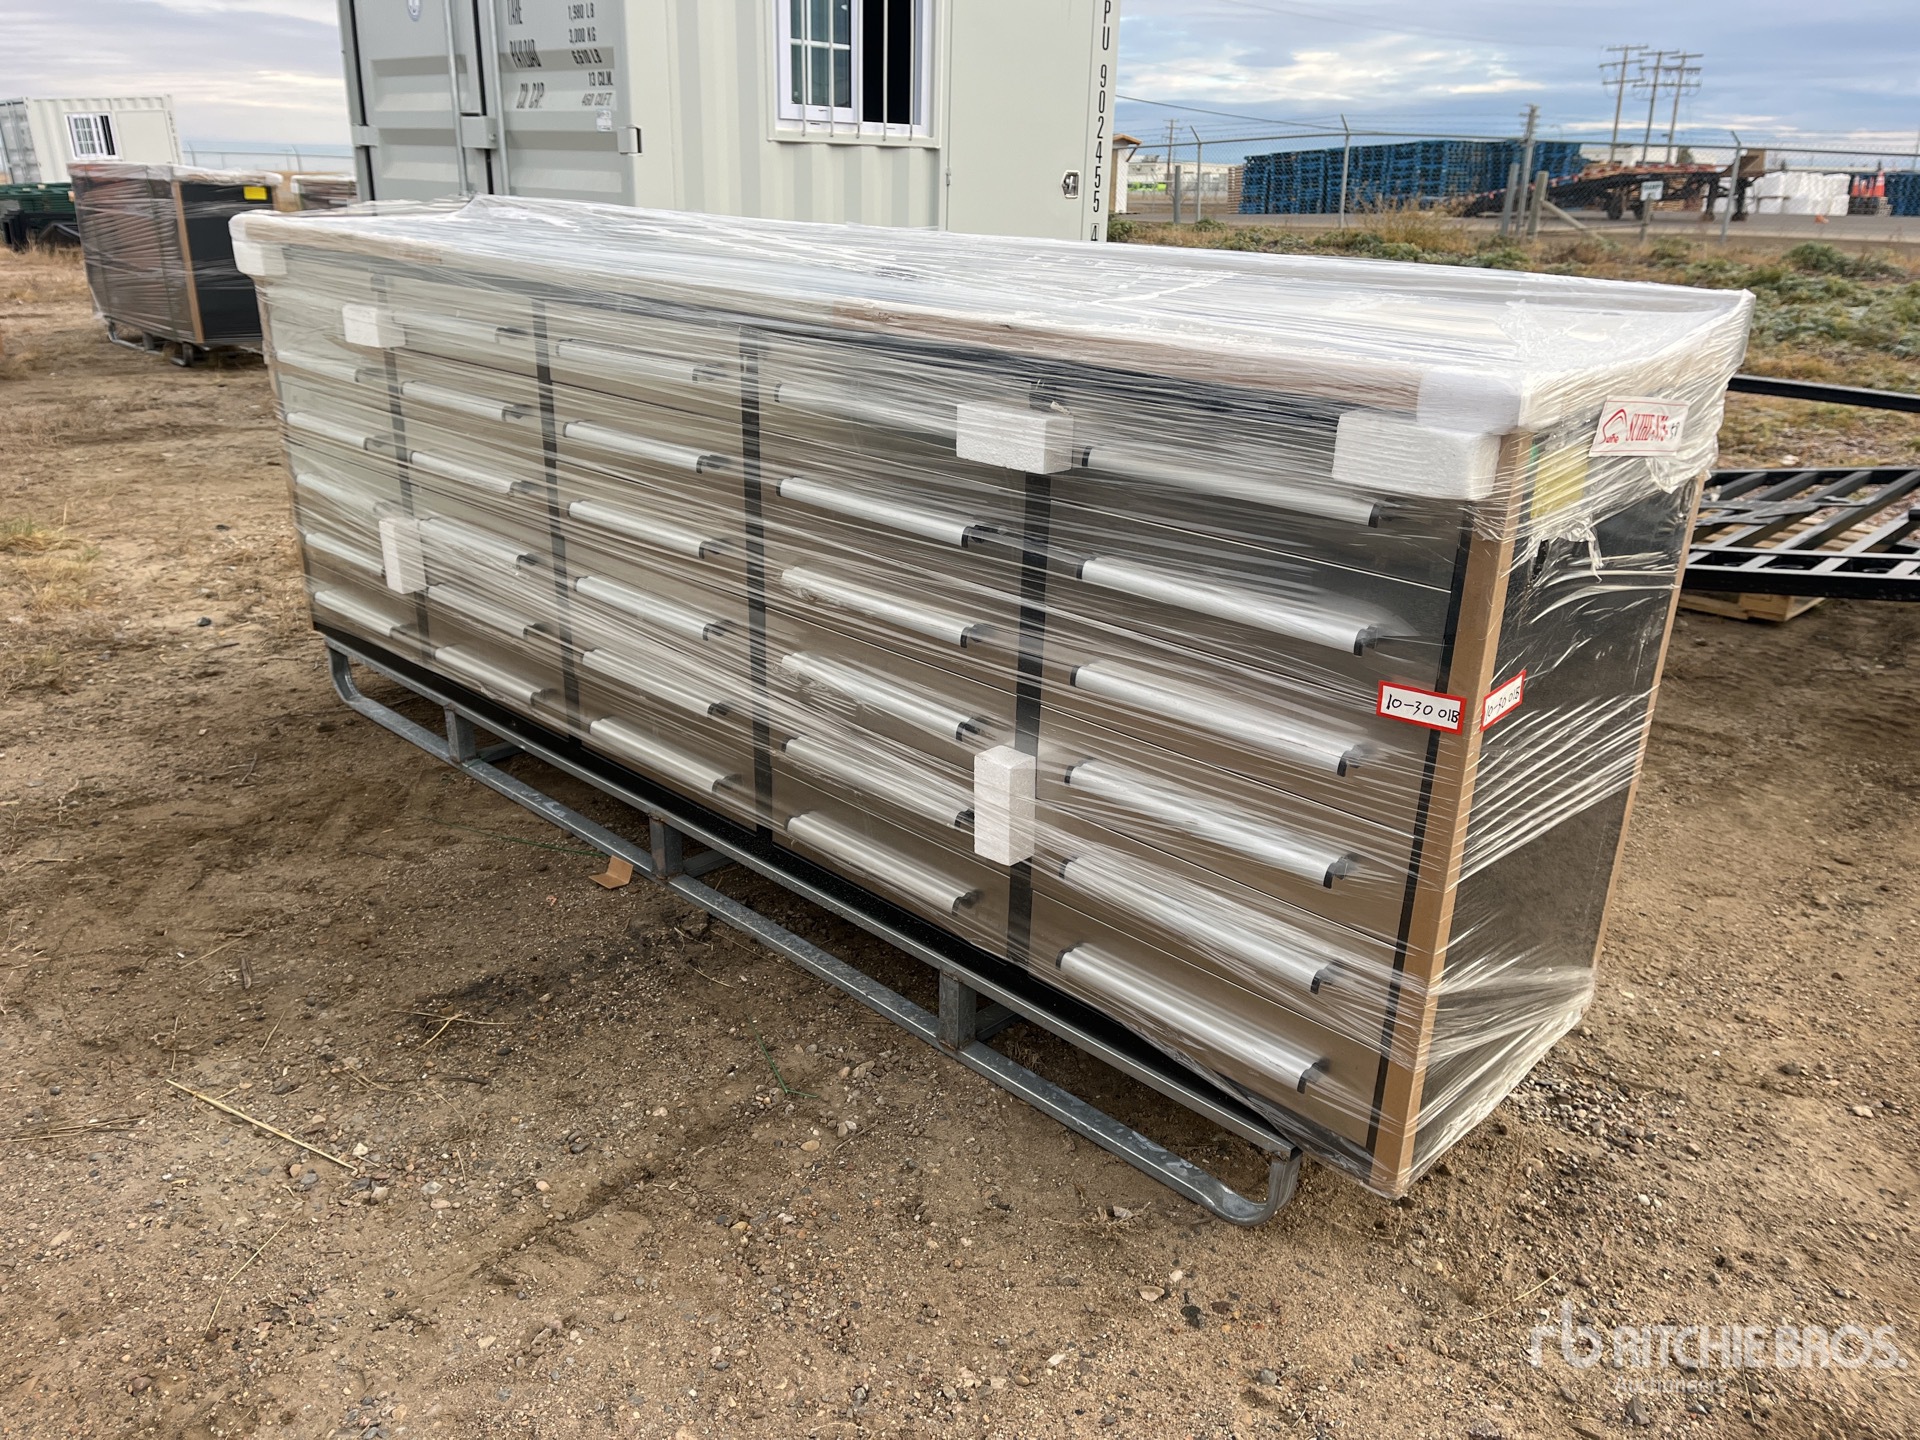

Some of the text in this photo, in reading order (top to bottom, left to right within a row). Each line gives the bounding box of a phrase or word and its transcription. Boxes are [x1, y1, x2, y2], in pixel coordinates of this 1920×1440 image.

[586, 3, 594, 18] LB
[587, 27, 596, 42] KG
[591, 49, 602, 64] LB
[588, 72, 596, 86] 13
[1093, 64, 1107, 213] 902455
[1386, 693, 1433, 716] 10-30
